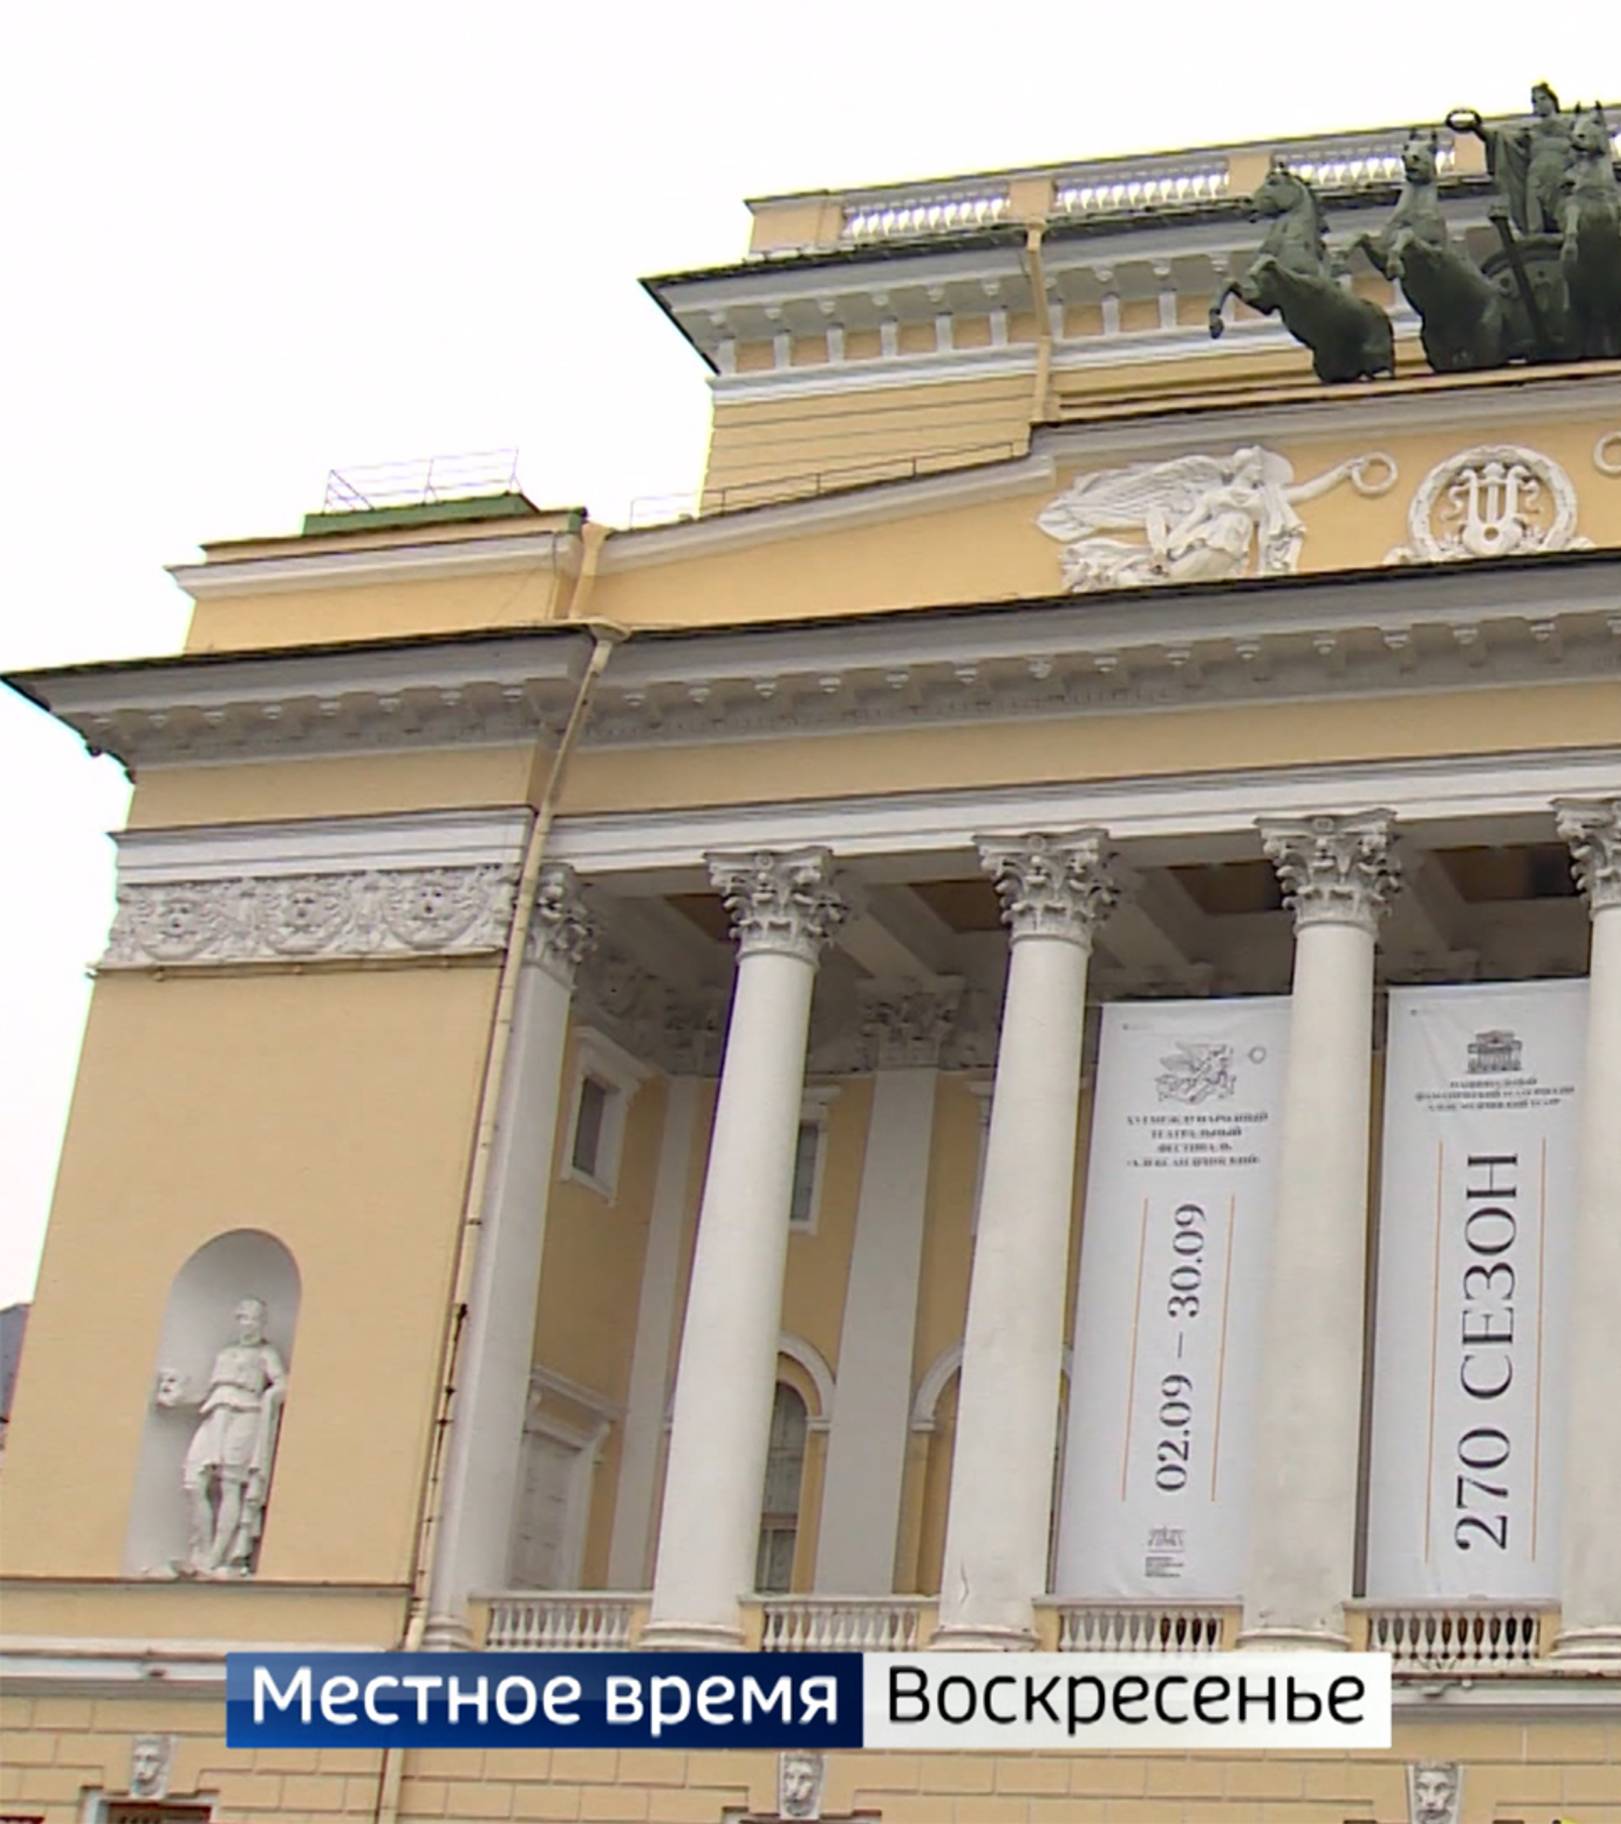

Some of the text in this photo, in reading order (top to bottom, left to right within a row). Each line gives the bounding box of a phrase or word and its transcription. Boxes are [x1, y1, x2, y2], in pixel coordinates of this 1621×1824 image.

[1166, 1202, 1207, 1319] 30.09
[1459, 1152, 1519, 1400] СЕЗОН
[1154, 1373, 1193, 1492] 02.09
[1453, 1427, 1512, 1551] 270
